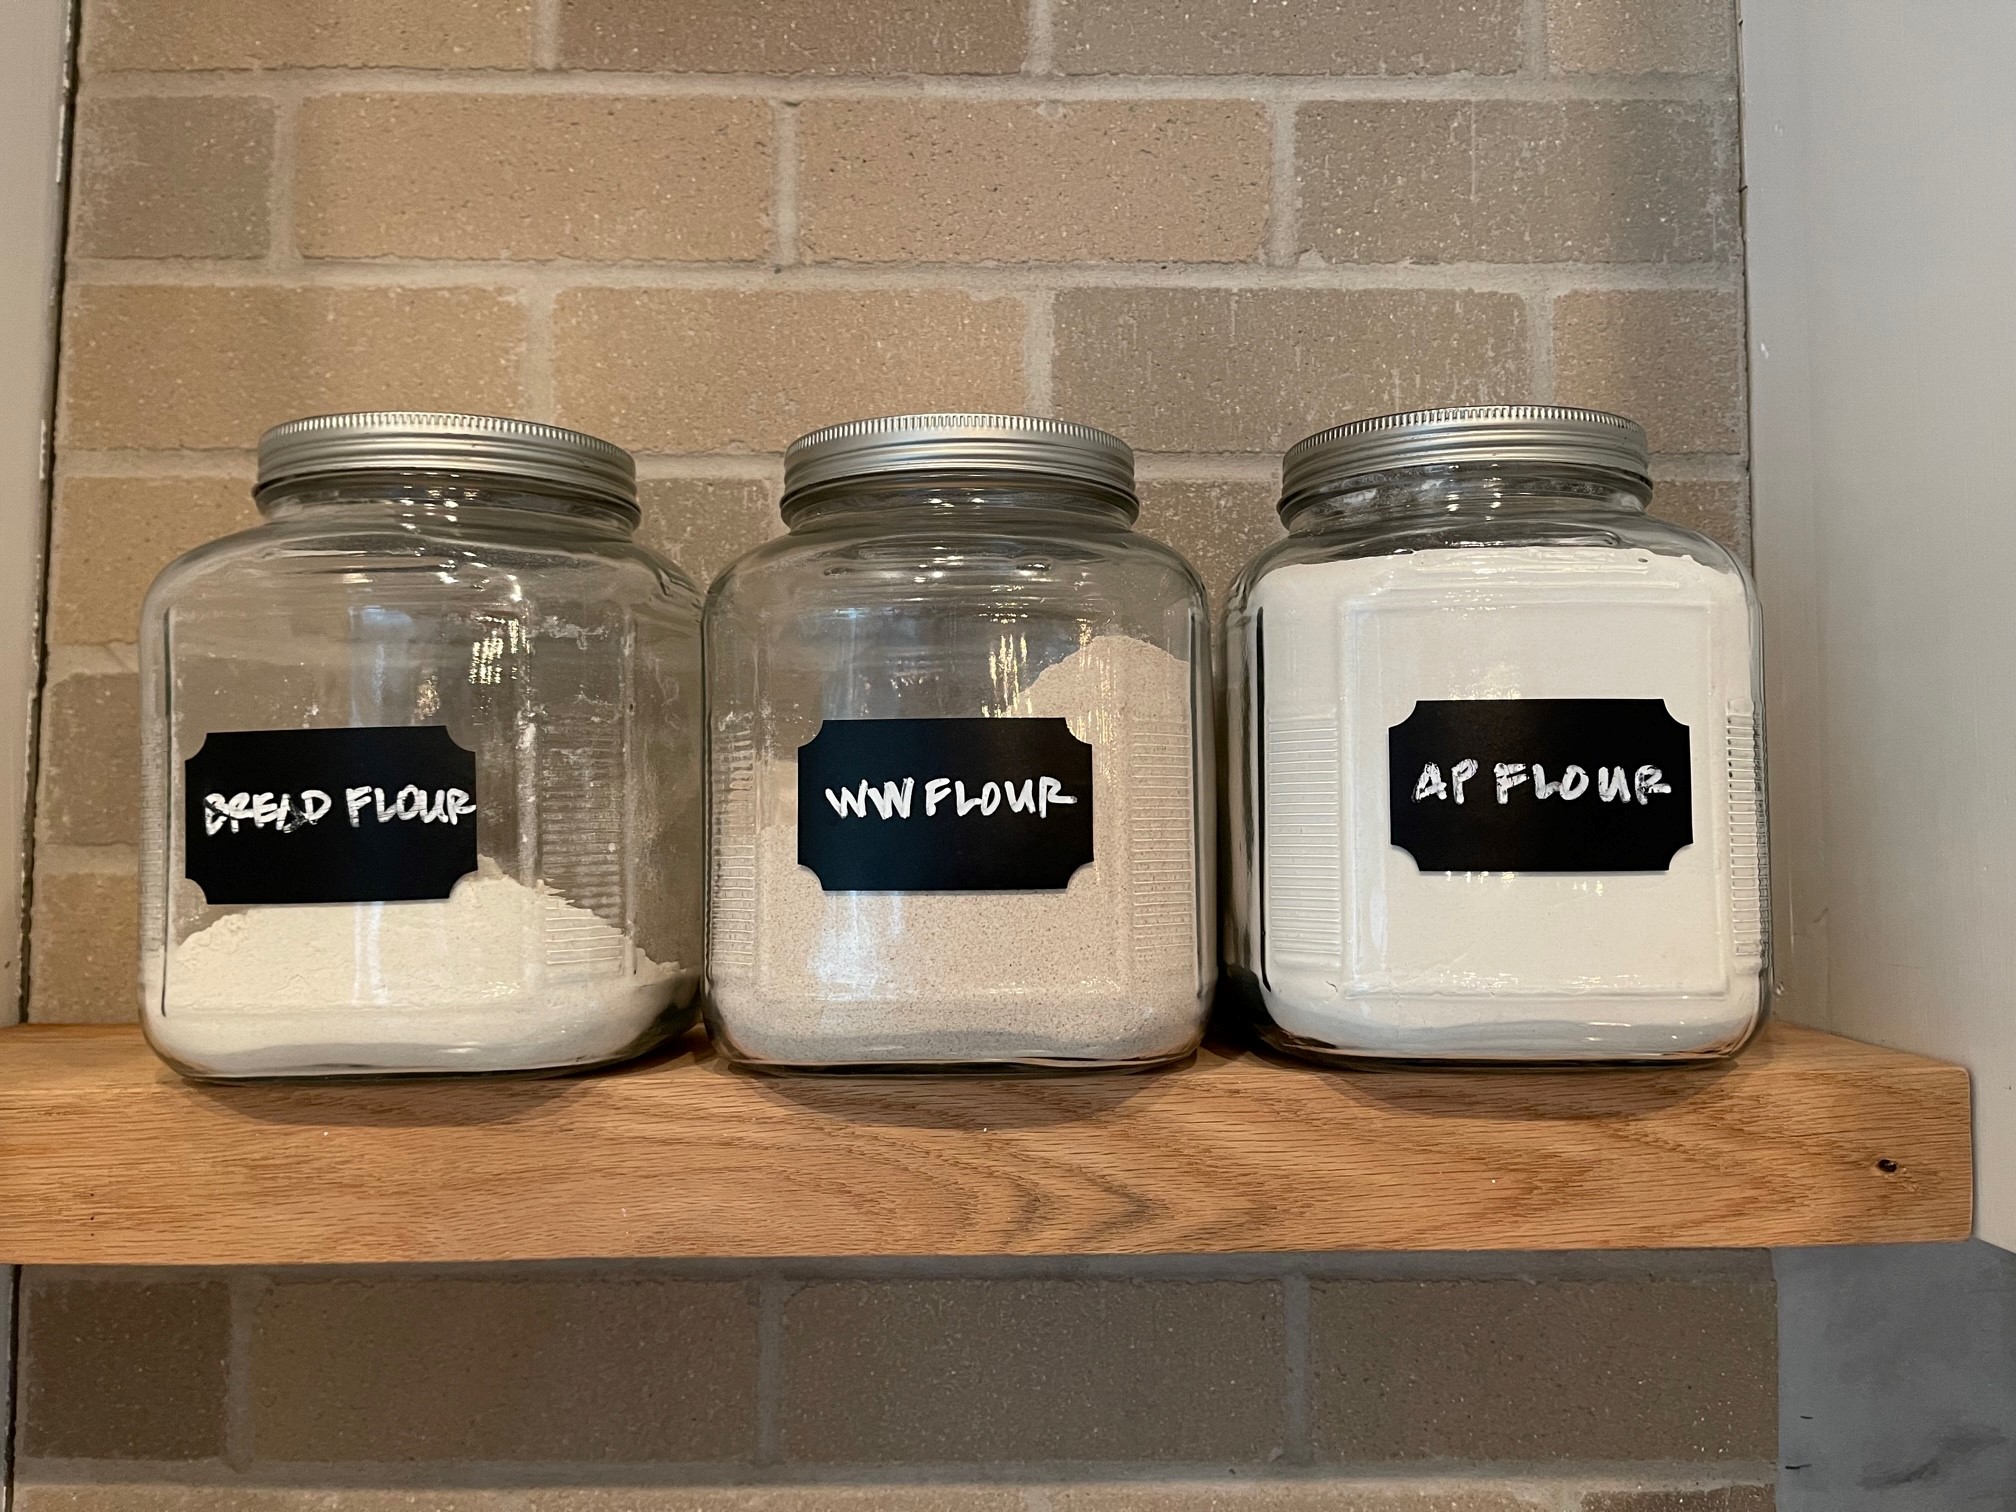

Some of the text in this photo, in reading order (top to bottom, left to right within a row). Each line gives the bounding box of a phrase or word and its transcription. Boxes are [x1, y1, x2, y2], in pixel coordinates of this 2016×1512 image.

[824, 775, 1078, 820] WW FLOUR
[1411, 758, 1673, 806] AP FLOUR
[203, 784, 478, 837] BREAD FLOUR
